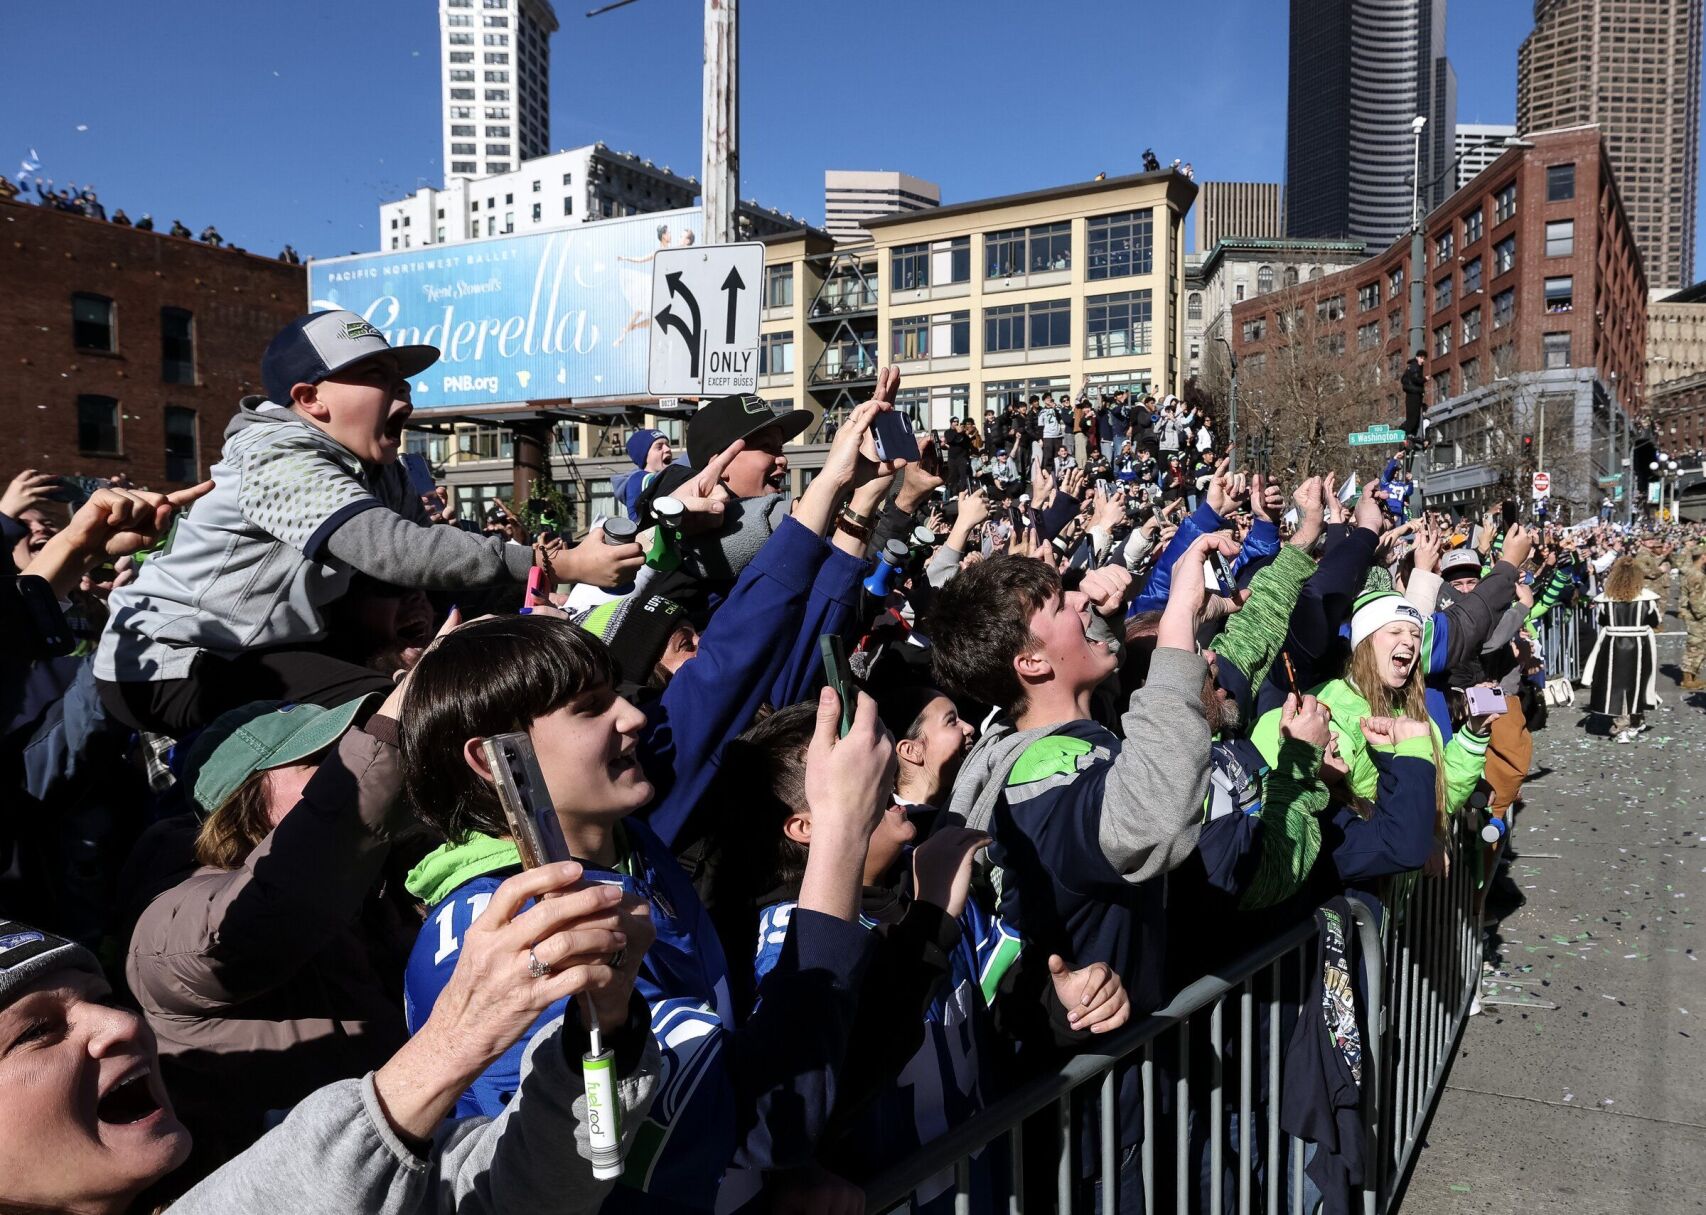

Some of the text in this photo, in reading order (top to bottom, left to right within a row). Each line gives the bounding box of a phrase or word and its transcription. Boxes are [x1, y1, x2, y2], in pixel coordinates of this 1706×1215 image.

[328, 250, 517, 282] PACIFIC NORTHWEST BALLET
[710, 351, 751, 373] ONLY
[443, 374, 498, 394] PNB.org
[708, 377, 754, 387] EXCEPT BUSES
[1358, 432, 1398, 443] Washington
